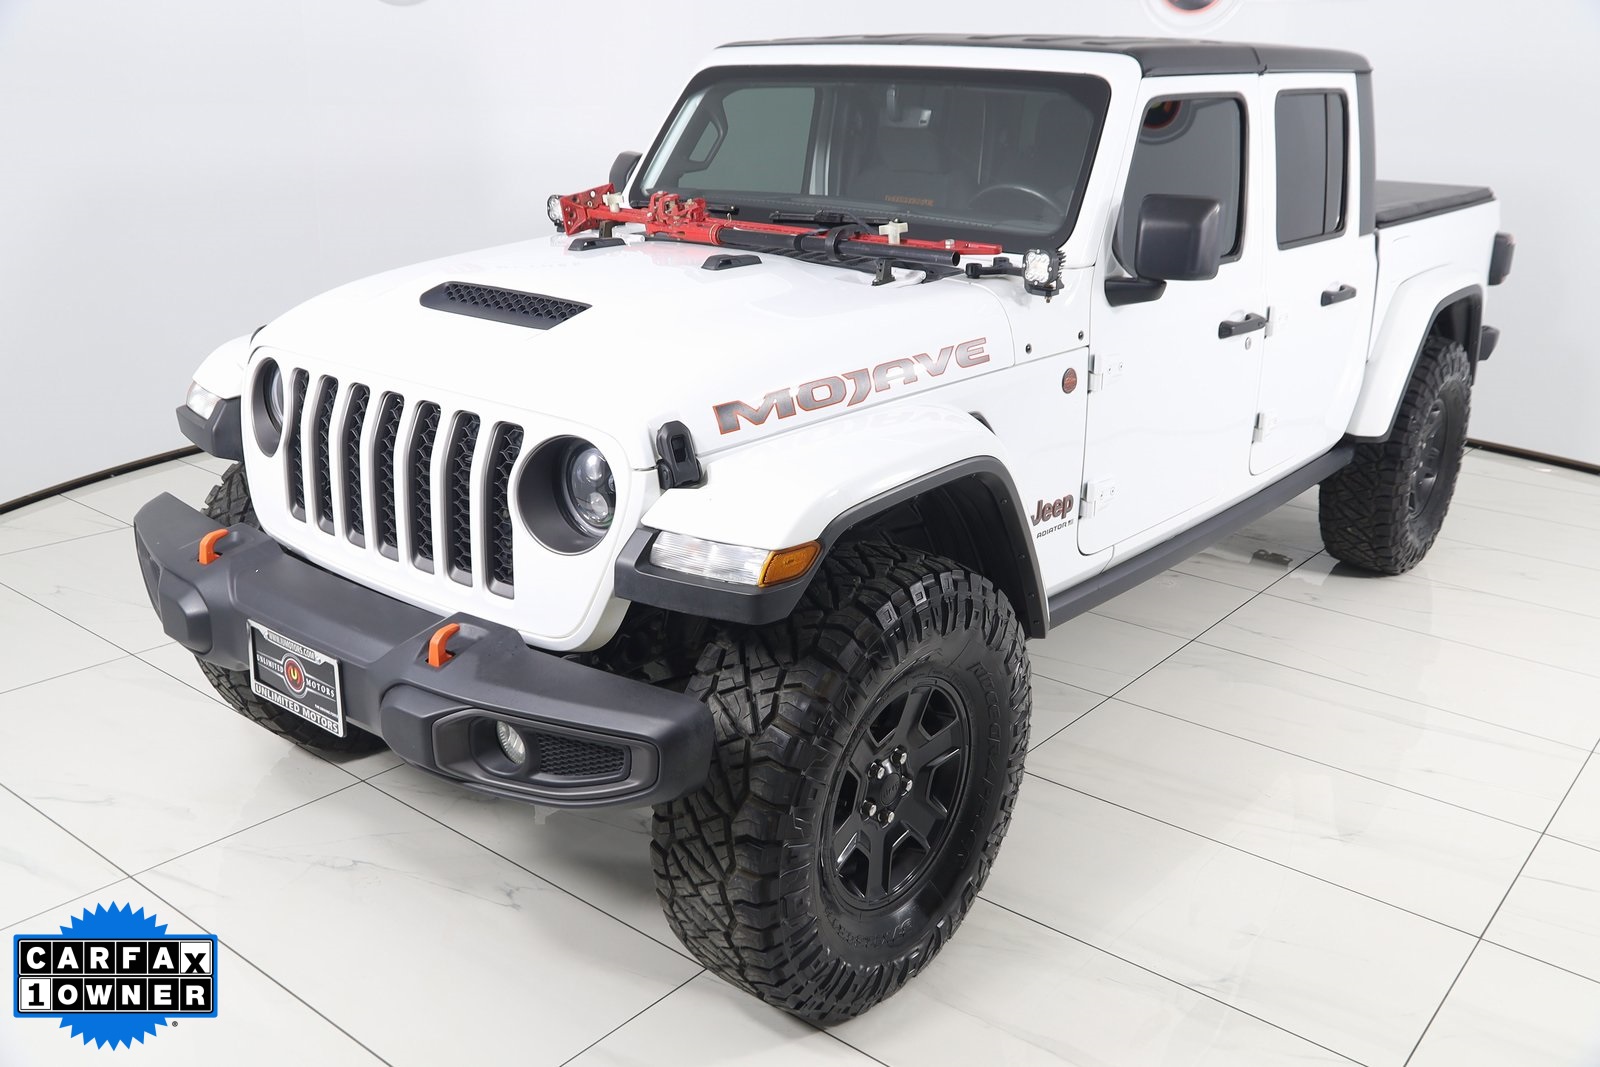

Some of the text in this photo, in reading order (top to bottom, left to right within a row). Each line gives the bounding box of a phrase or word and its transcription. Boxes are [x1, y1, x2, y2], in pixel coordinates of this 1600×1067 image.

[712, 337, 990, 435] MOJAVE
[1030, 494, 1074, 526] Jeep
[256, 653, 284, 674] UNLIMITED
[305, 677, 335, 698] MOTORS
[255, 683, 300, 713] UNLIMITED
[302, 706, 339, 733] MOTORS
